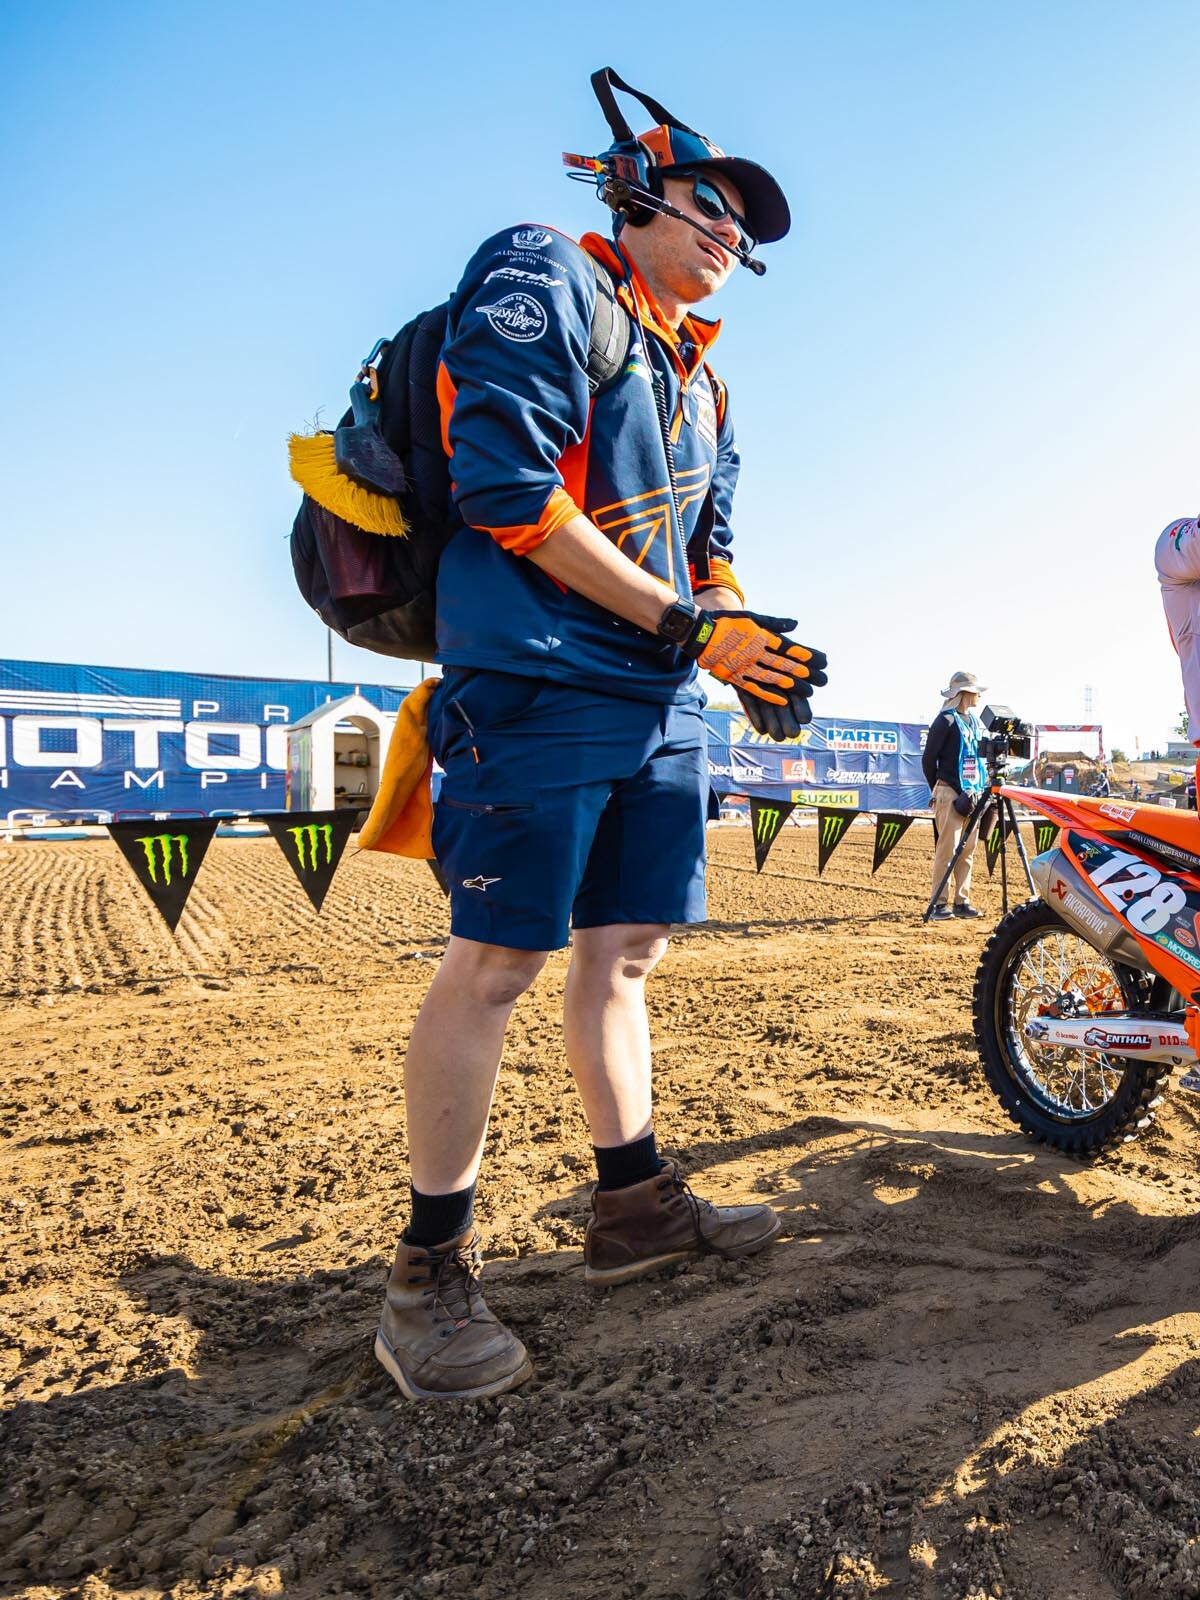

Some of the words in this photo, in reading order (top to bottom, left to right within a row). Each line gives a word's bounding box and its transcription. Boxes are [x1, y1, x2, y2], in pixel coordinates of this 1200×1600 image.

[0, 714, 288, 770] OTO
[827, 728, 898, 743] PARTS
[708, 764, 764, 779] usqvarna
[0, 770, 267, 789] AMPI
[797, 793, 854, 804] SUZUKI
[1088, 850, 1187, 935] 128
[1159, 1035, 1180, 1046] DID
